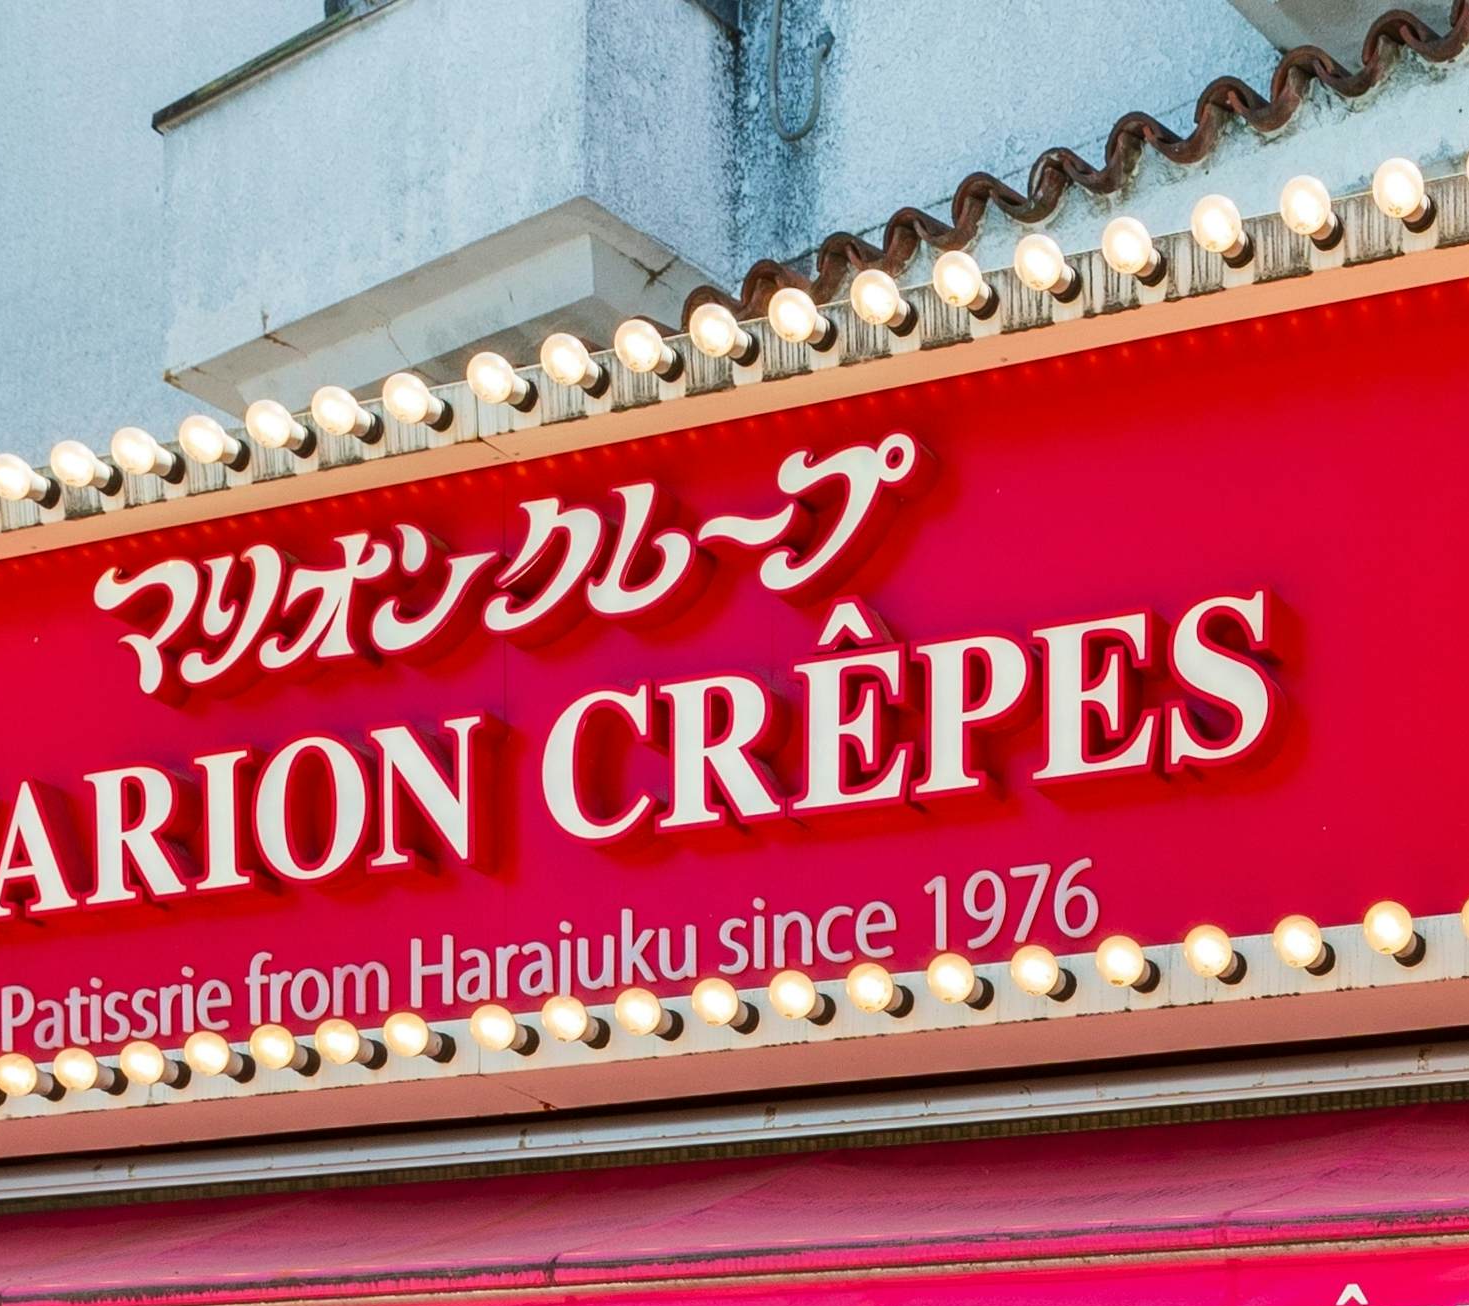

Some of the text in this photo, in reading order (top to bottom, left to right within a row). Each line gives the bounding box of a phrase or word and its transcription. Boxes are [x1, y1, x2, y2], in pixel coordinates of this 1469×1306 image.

[93, 430, 917, 696] マリオンクレープ
[541, 590, 1271, 842] CRÊPES
[245, 950, 394, 1026] from
[409, 907, 697, 1006] Harajuku
[717, 898, 898, 976] since
[923, 857, 1100, 952] 1976
